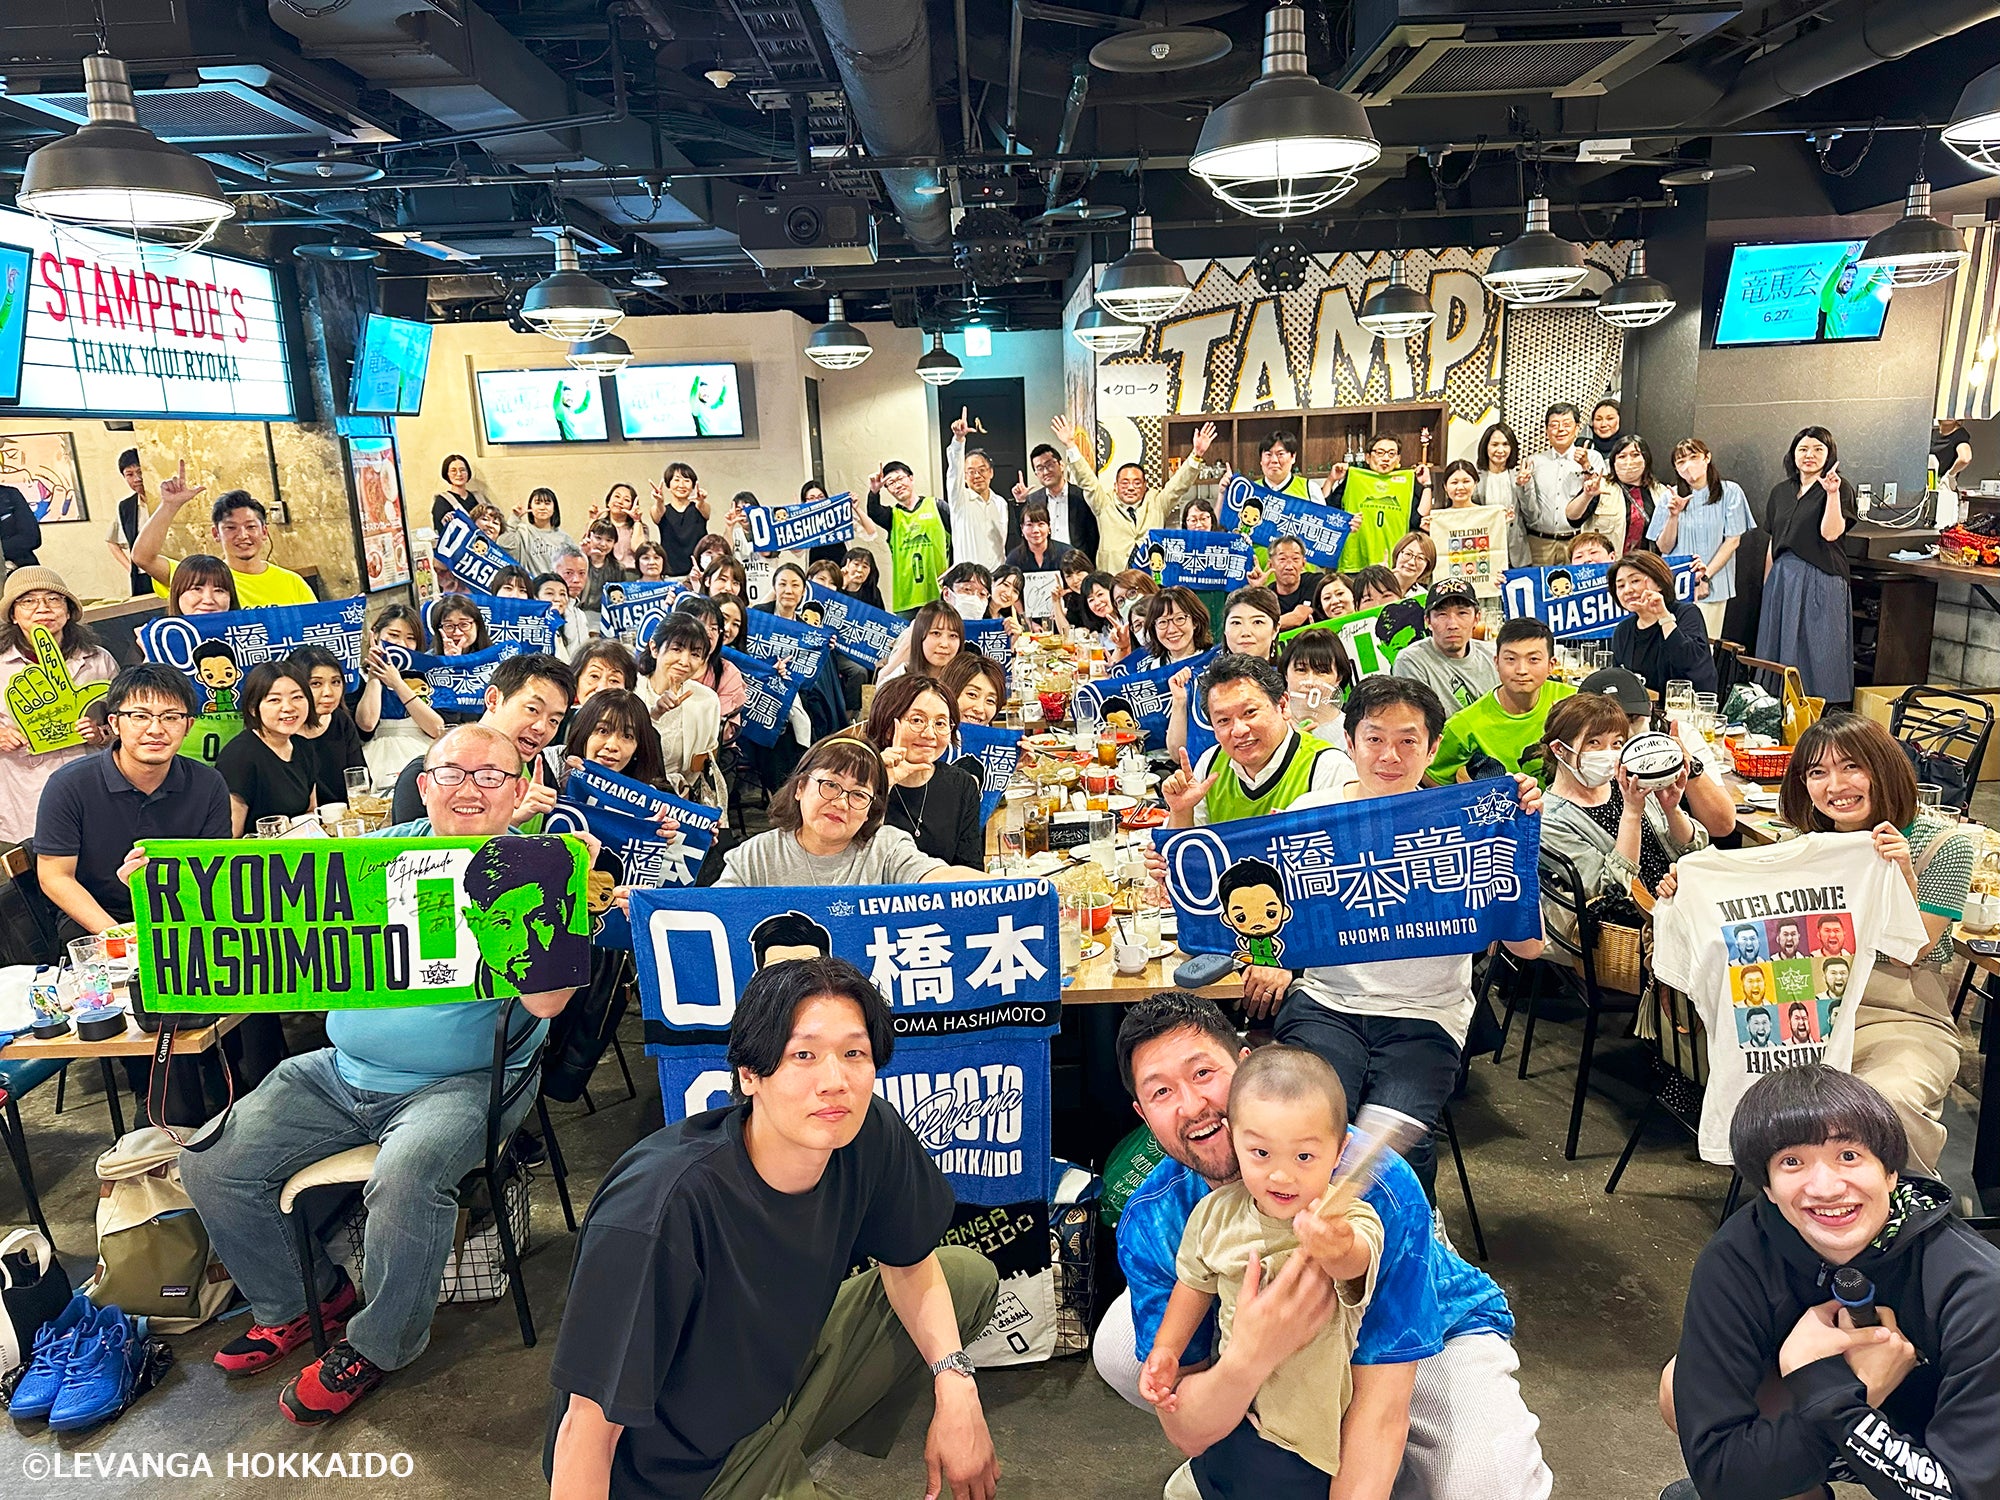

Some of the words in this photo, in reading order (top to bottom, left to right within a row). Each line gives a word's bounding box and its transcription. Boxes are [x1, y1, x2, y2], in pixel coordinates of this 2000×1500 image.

[40, 252, 248, 343] STAMPEDE'S
[1741, 268, 1822, 304] 竜馬会
[1763, 310, 1789, 323] 6.27
[68, 337, 136, 376] THANK
[140, 345, 182, 379] YOU!
[185, 350, 241, 382] RYOMA
[1113, 382, 1159, 396] クローク
[775, 501, 852, 546] HASHIMOTO
[587, 775, 647, 808] LEVANGA
[649, 799, 718, 831] HOKKAIDO
[148, 852, 354, 923] RYOMA
[859, 893, 945, 915] LEVANGA
[951, 879, 1049, 909] HOKKAIDO
[1716, 886, 1846, 922] WELCOME
[1338, 926, 1390, 947] RYOMA
[1394, 917, 1478, 939] HASHIMOTO
[156, 925, 409, 996] HASHIMOTO
[866, 915, 1048, 1006] 橋本
[891, 1017, 938, 1033] OMA
[944, 1007, 1046, 1030] HASHIMOTO
[158, 1032, 171, 1063] Canon
[907, 1087, 1024, 1150] Ryoma
